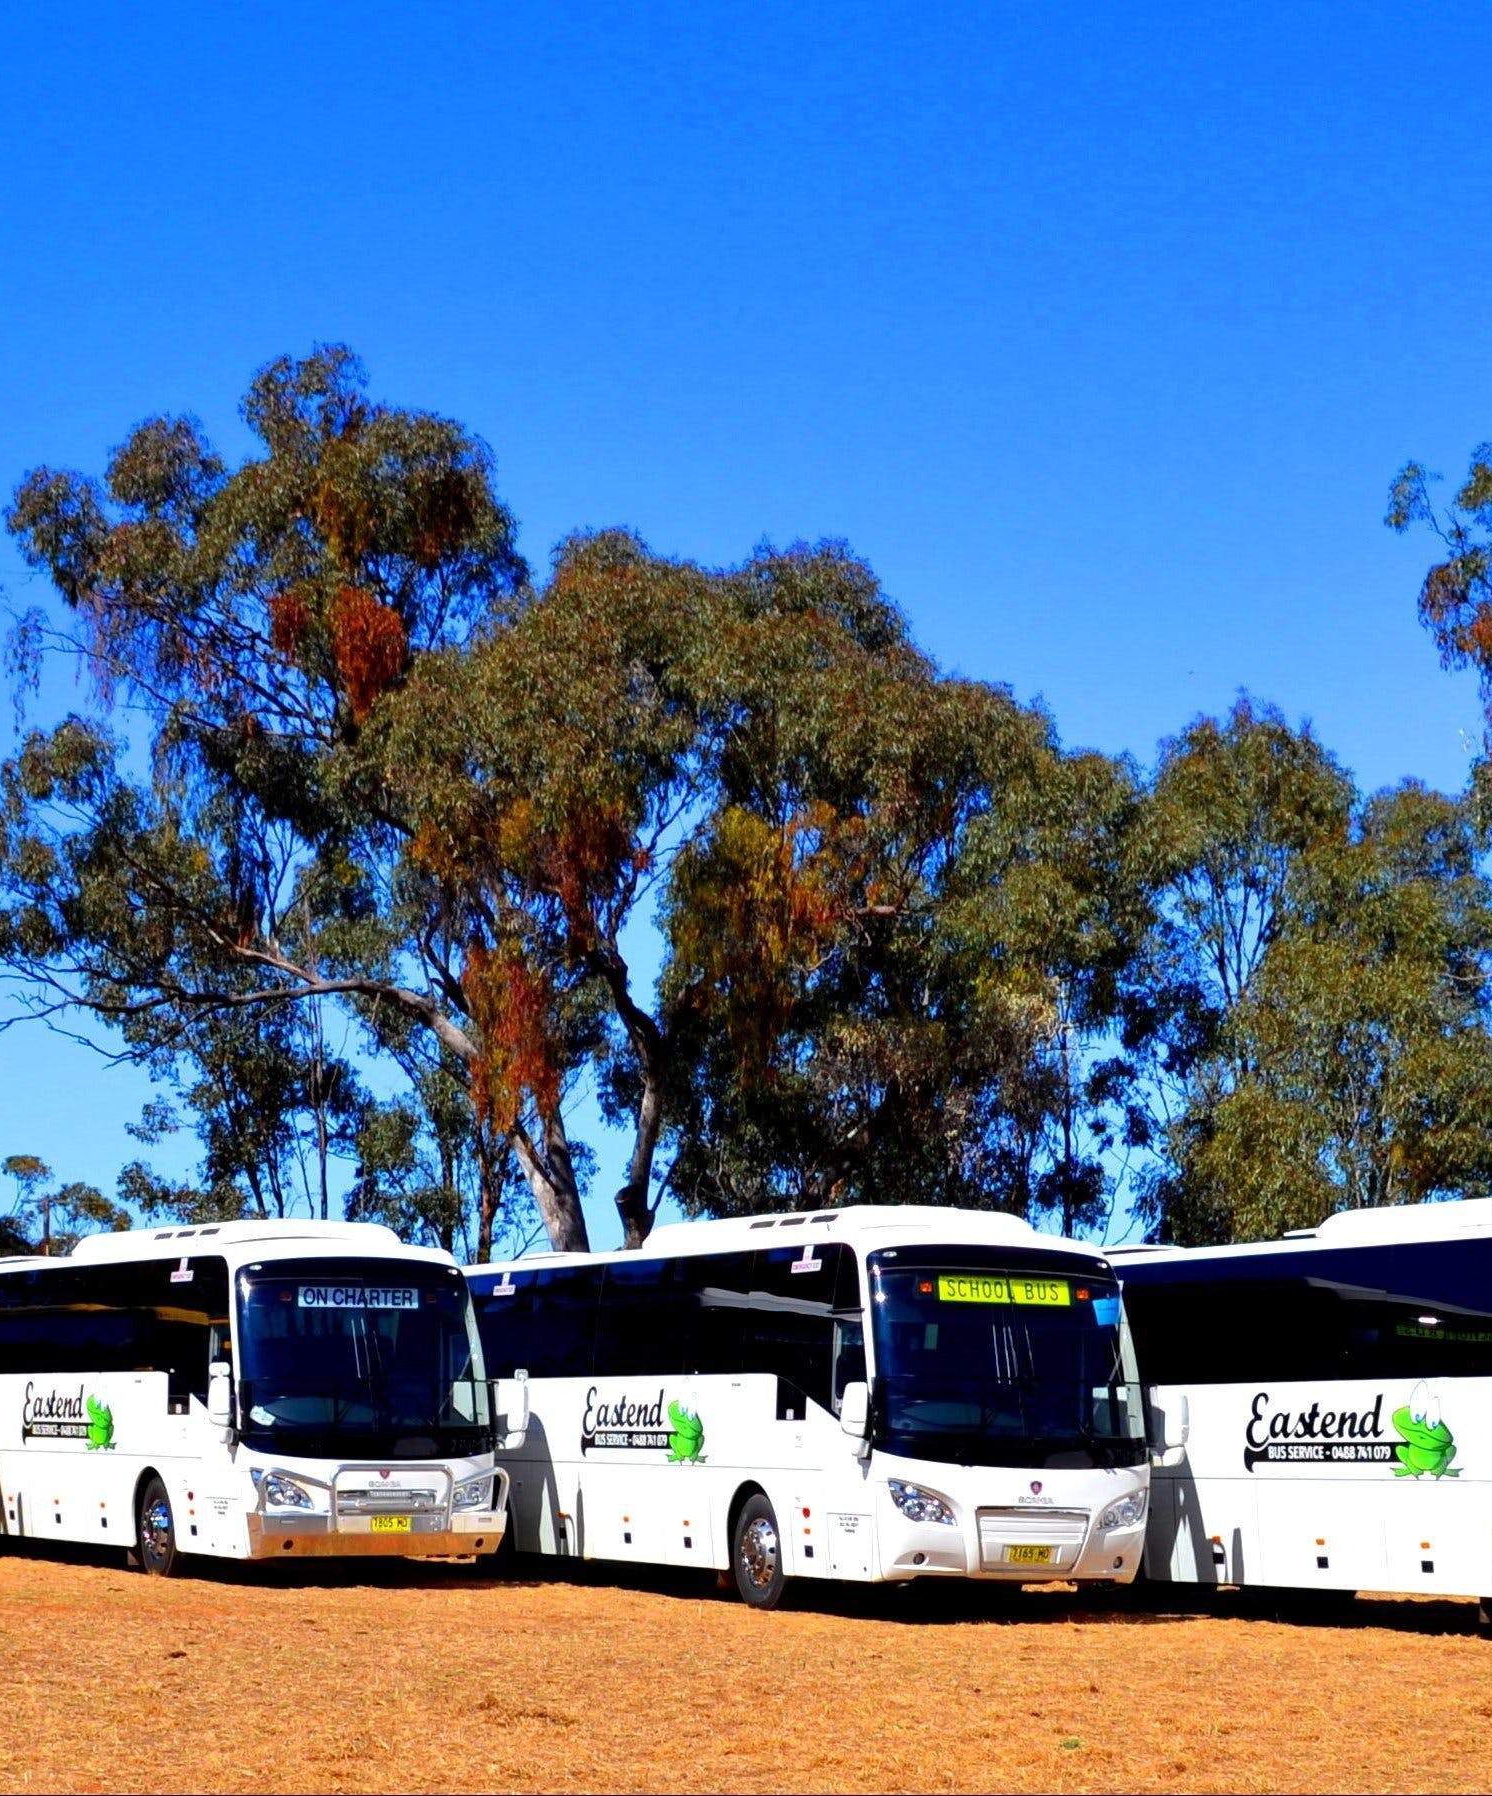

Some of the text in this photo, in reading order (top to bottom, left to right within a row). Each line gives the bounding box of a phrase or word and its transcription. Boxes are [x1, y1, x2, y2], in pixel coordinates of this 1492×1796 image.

[303, 1288, 413, 1306] ON CHARTER
[947, 1279, 1059, 1301] SCHOOL BUS
[22, 1381, 84, 1426] Eastend
[582, 1386, 665, 1436] Eastend
[1245, 1392, 1385, 1449] Eastend
[1268, 1445, 1287, 1459] BUS
[1287, 1445, 1325, 1459] SERVICE
[1331, 1445, 1356, 1460] 0488
[1357, 1445, 1373, 1460] 741
[1373, 1445, 1391, 1460] 079
